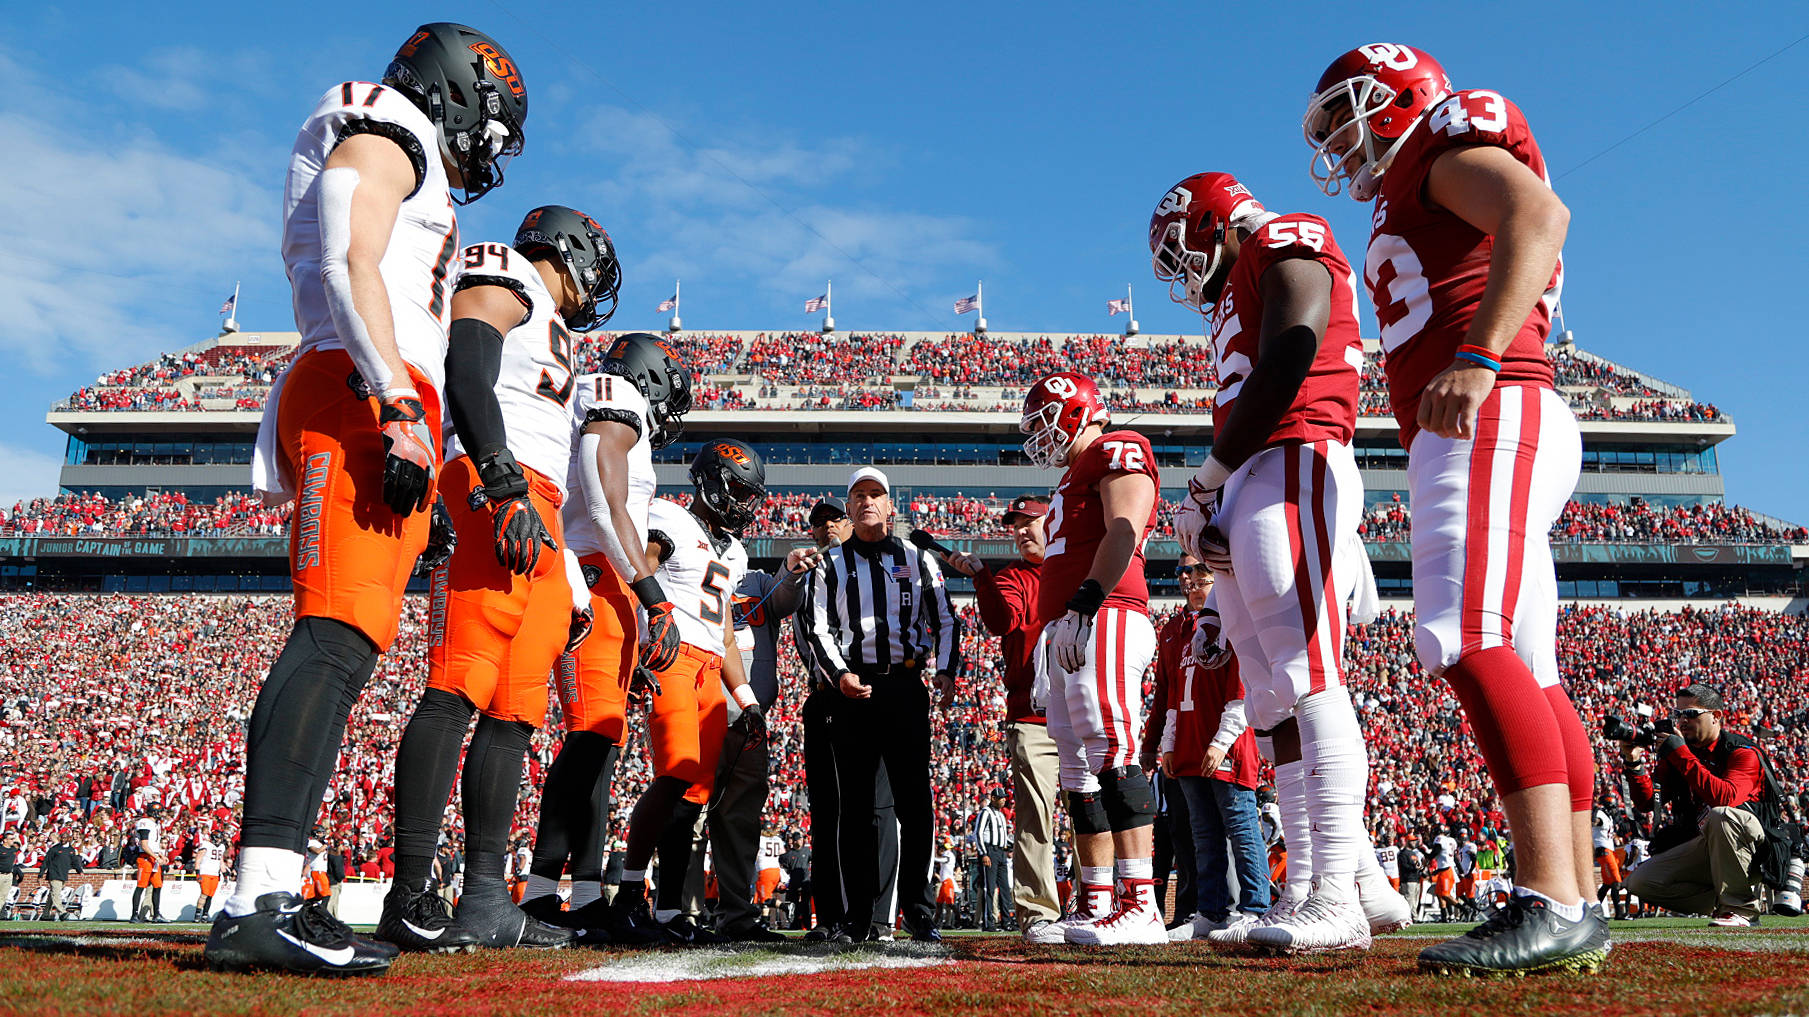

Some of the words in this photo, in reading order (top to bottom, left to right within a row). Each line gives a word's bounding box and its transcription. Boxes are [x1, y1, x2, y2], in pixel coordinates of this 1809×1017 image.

[467, 41, 526, 98] OSU
[1357, 42, 1418, 71] OU
[341, 81, 387, 107] 17
[1428, 91, 1508, 137] 43
[1155, 186, 1193, 217] OU
[1268, 221, 1326, 252] 55
[465, 244, 509, 271] 94
[1364, 233, 1434, 354] 3
[536, 318, 575, 410] 9
[595, 377, 613, 402] 11
[1044, 376, 1078, 400] OU
[713, 443, 752, 466] OSU
[1103, 440, 1145, 470] 72
[297, 451, 332, 571] COWBOYS
[1043, 493, 1067, 561] 2
[40, 542, 74, 553] JUNIOR
[75, 539, 121, 557] CAPTAIN
[134, 541, 166, 555] GAME
[976, 543, 1010, 555] JUNIOR
[700, 560, 730, 627] 5
[901, 592, 913, 607] R
[1180, 666, 1197, 712] 1
[765, 842, 781, 857] 50
